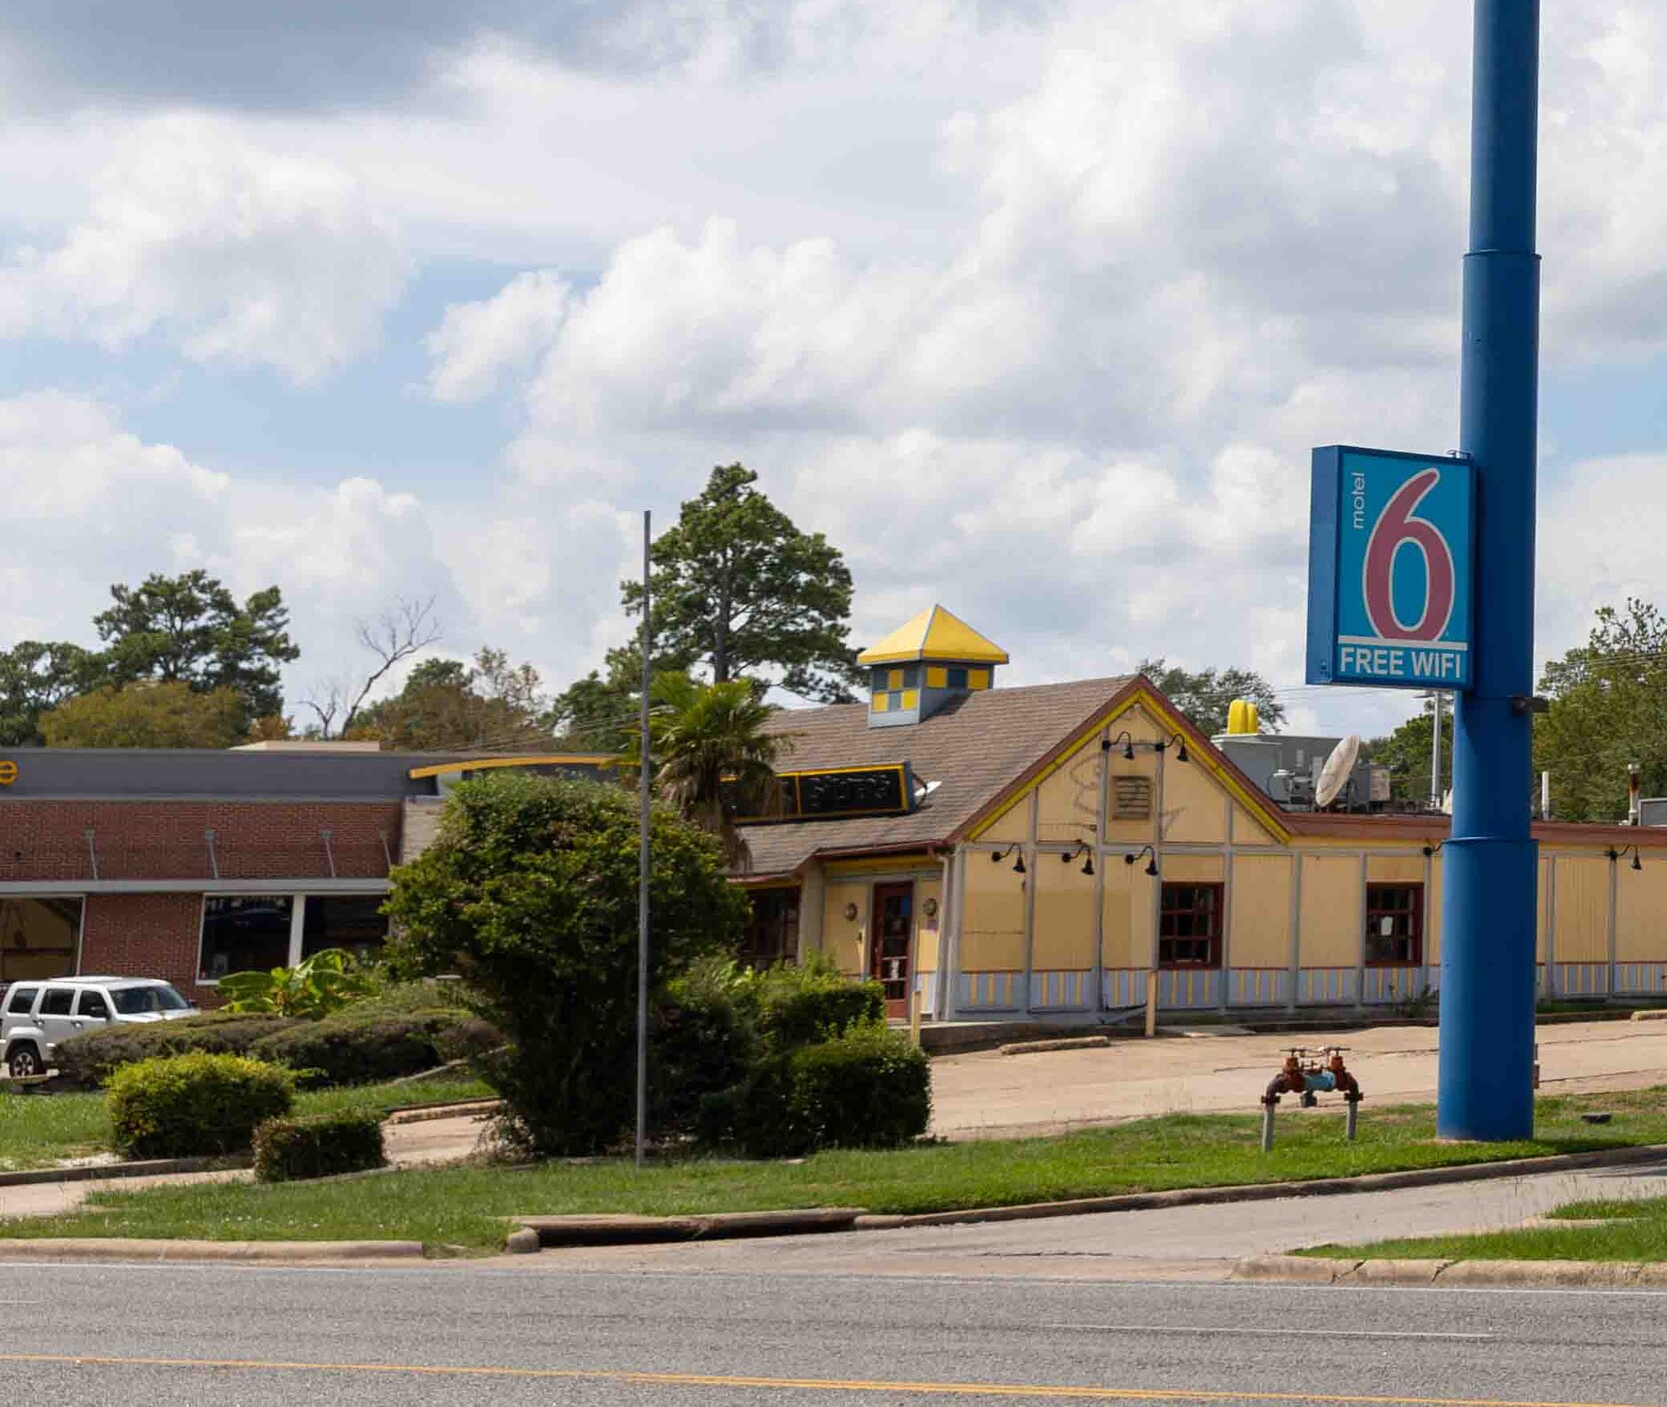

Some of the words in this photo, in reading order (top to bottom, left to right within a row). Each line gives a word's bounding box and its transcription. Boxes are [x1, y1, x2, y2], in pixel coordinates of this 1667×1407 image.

[1351, 472, 1366, 530] motel
[1362, 467, 1456, 641] 6
[1340, 646, 1405, 675] FREE
[1411, 651, 1461, 679] WIFI
